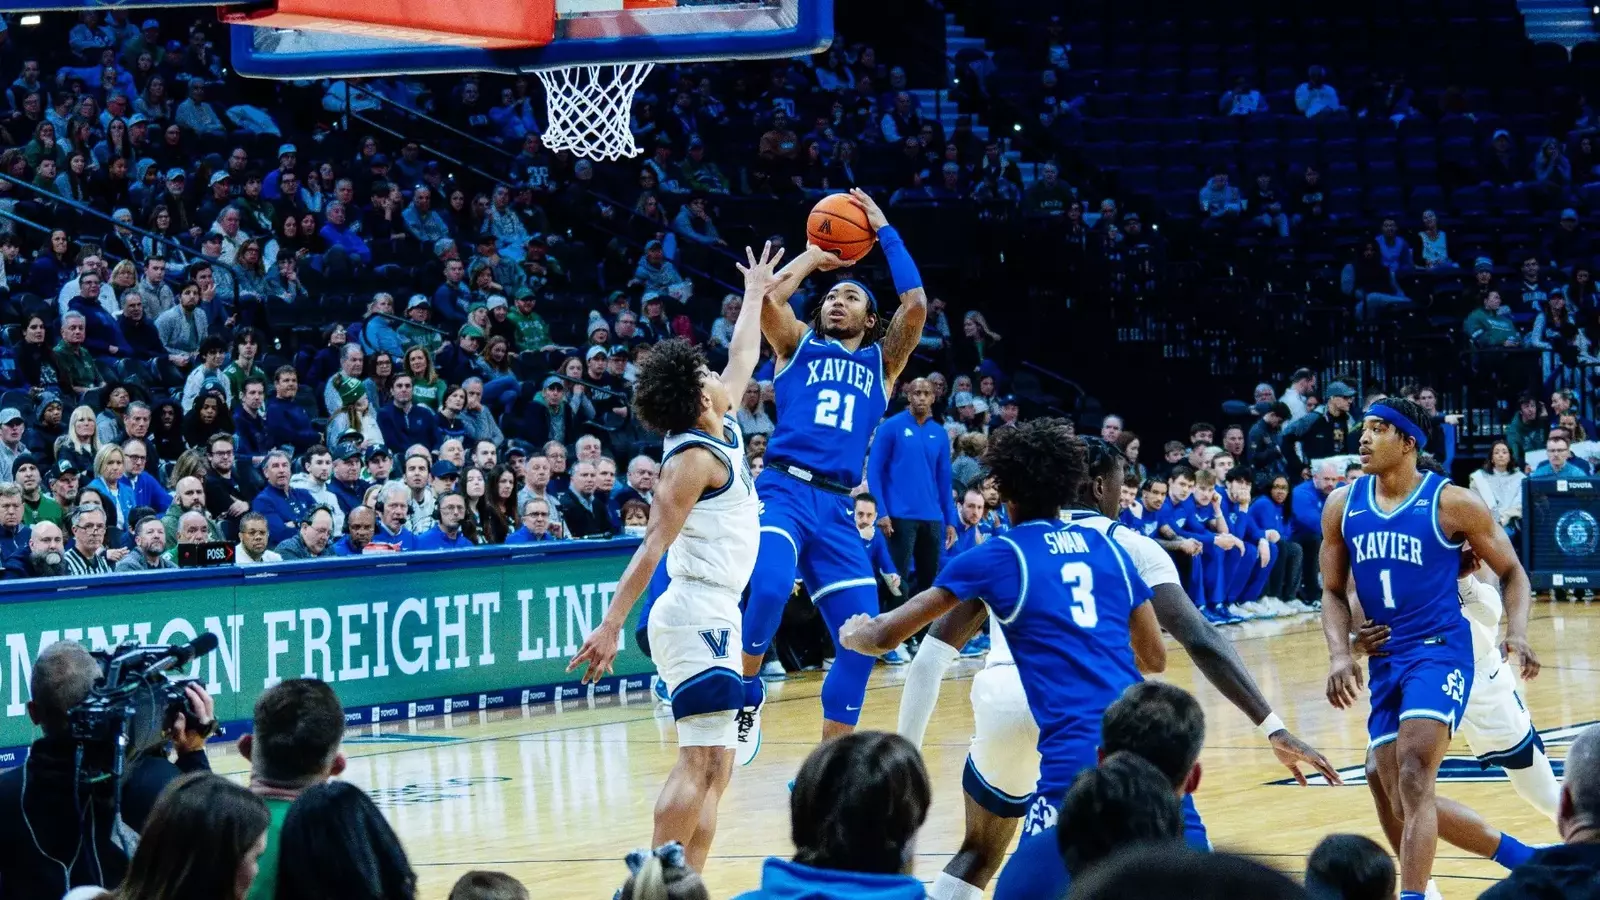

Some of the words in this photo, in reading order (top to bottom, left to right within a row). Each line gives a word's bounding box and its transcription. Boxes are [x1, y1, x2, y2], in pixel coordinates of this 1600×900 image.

[806, 358, 874, 399] XAVIER
[814, 388, 856, 432] 21
[1043, 531, 1090, 554] SWAIN
[1352, 531, 1423, 566] XAVIER
[1060, 561, 1098, 628] 3
[1379, 569, 1396, 609] 1
[263, 591, 500, 688] FREIGHT
[698, 627, 731, 659] V
[380, 708, 399, 717] TOYOTA
[417, 704, 435, 713] TOYOTA
[452, 700, 470, 708] TOYOTA
[487, 695, 504, 704] TOYOTA
[0, 753, 15, 761] YOTA
